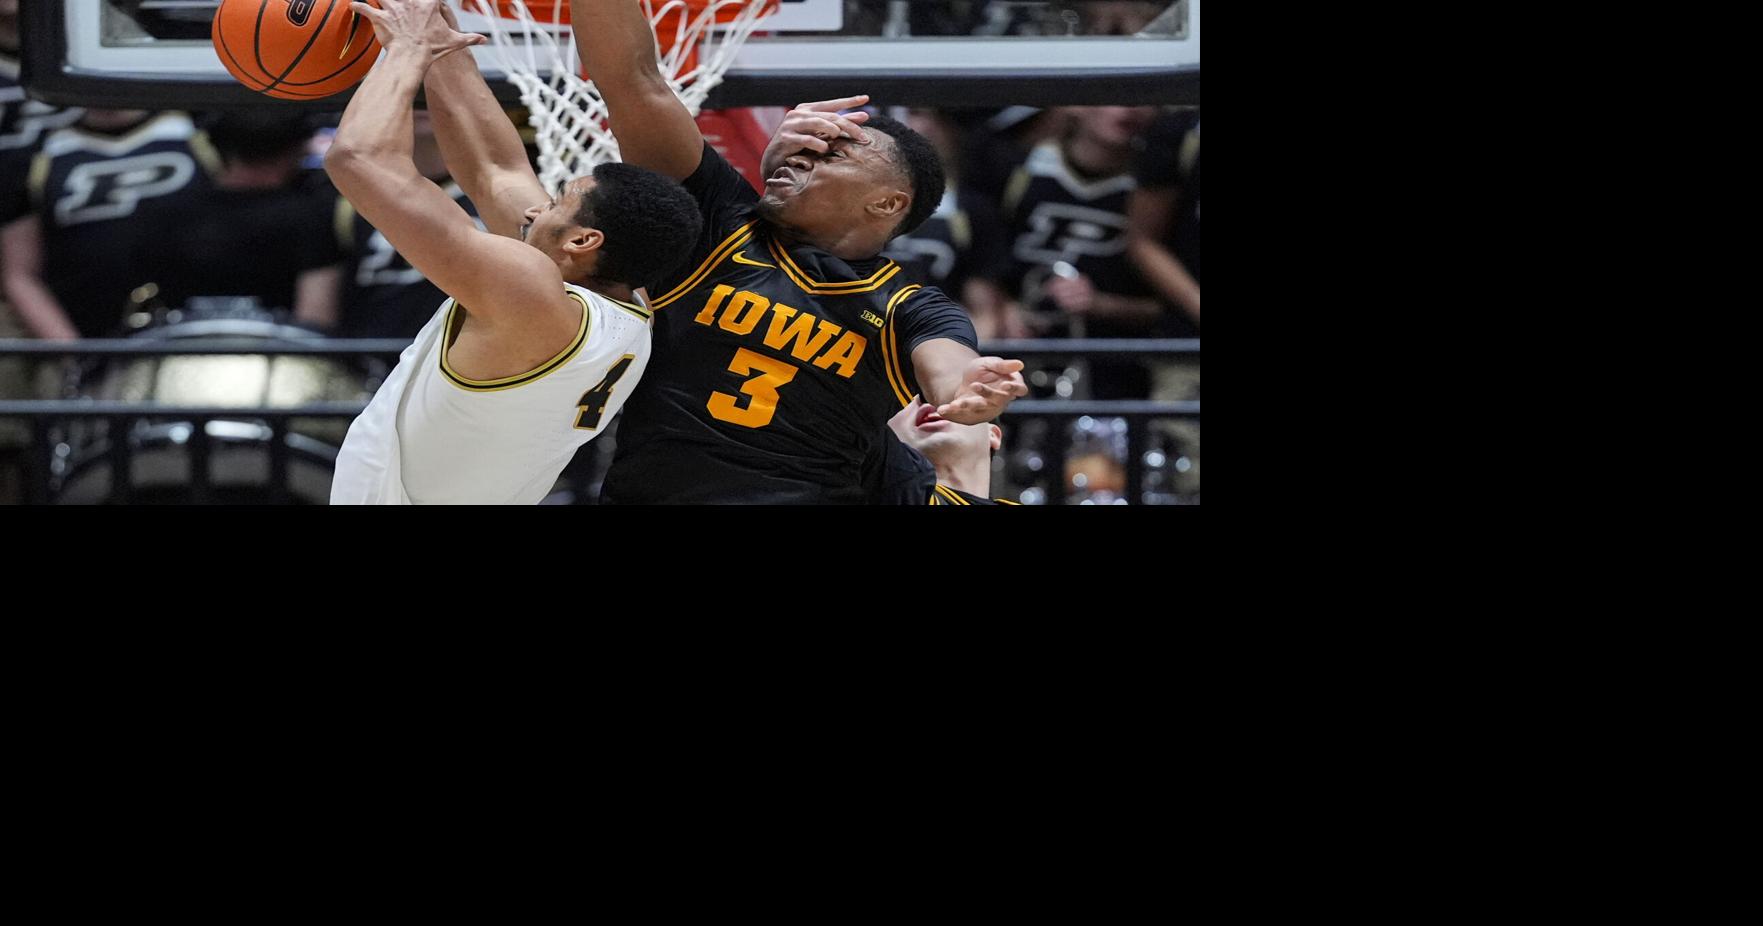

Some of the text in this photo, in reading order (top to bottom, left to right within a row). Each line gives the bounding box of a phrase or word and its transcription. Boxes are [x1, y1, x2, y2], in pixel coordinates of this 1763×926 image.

[54, 151, 195, 226] P
[694, 284, 868, 379] IOWA
[573, 353, 636, 431] 4
[706, 347, 799, 429] 3
